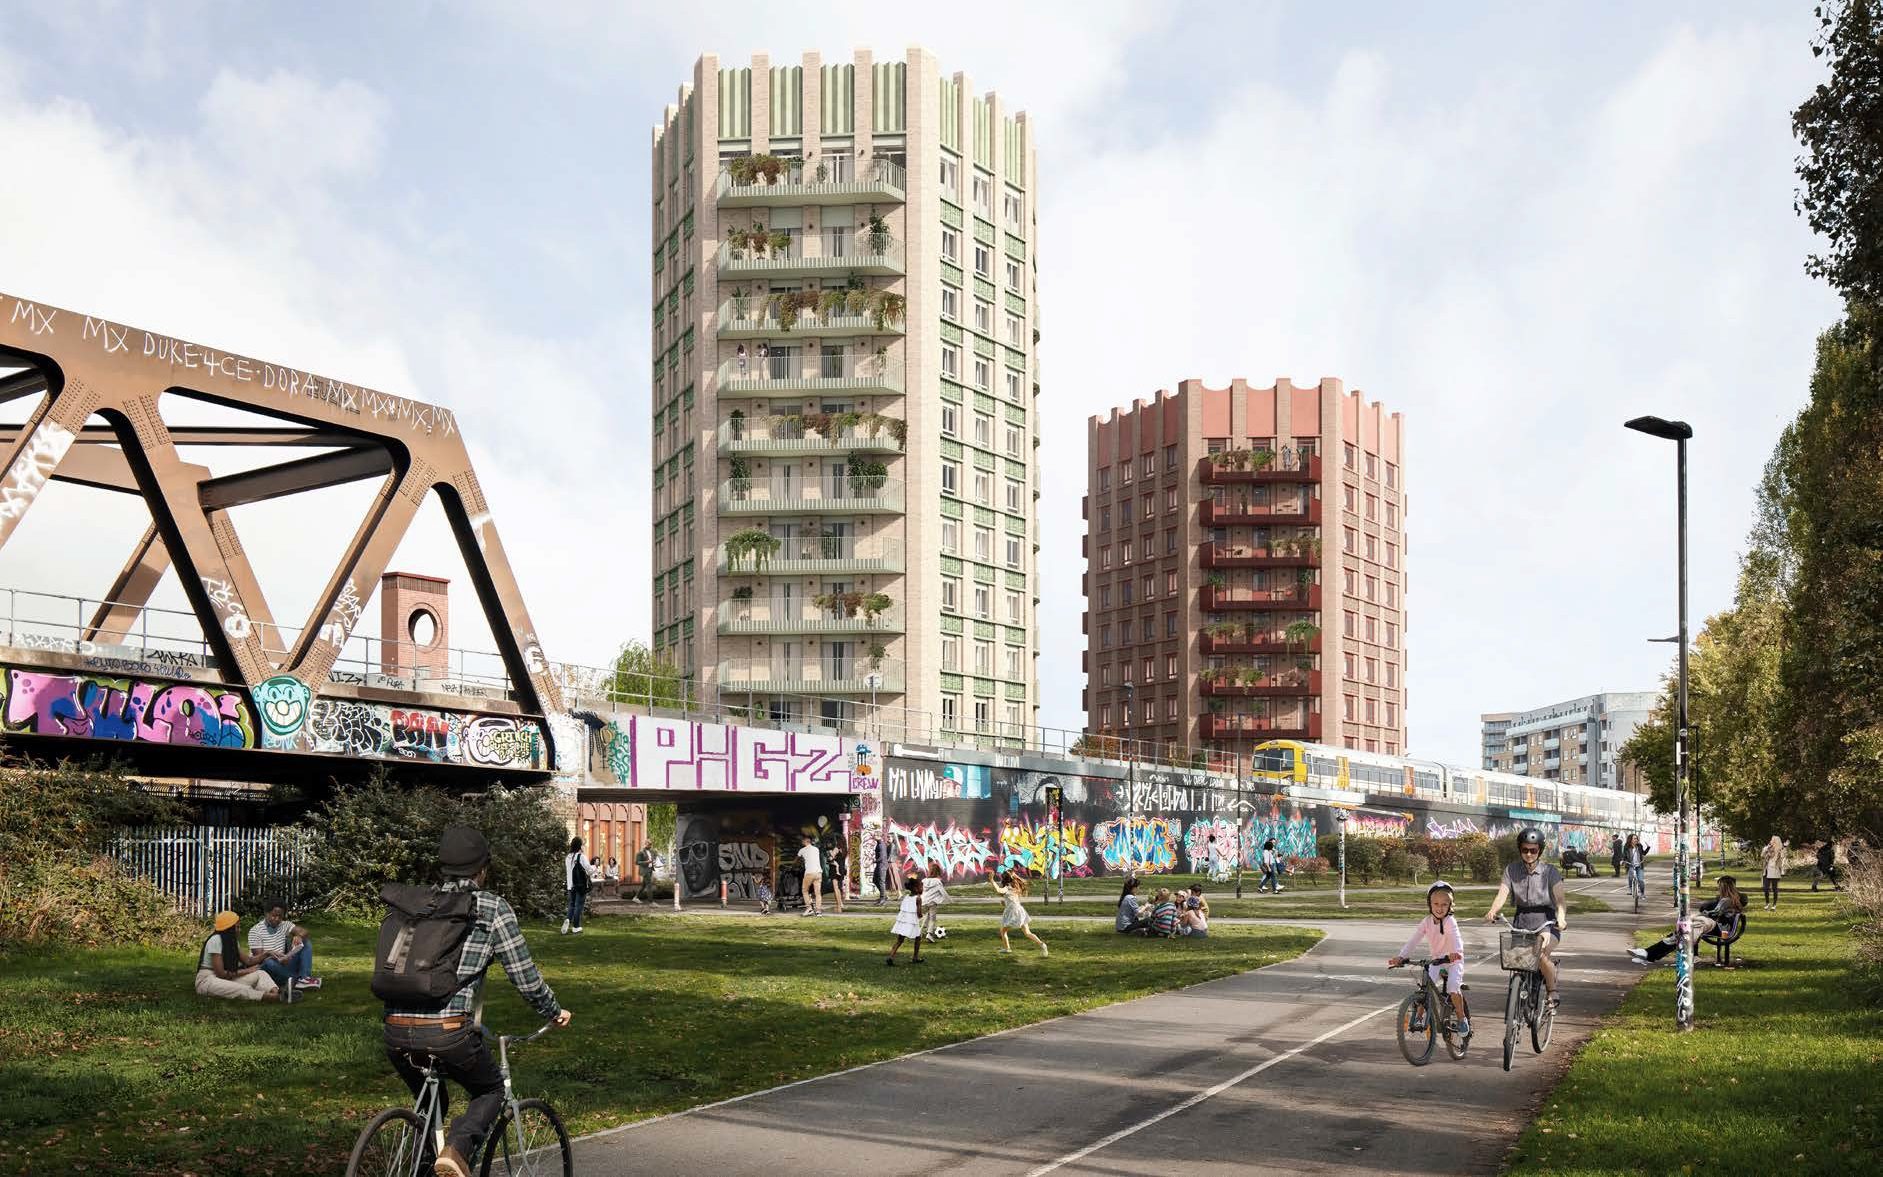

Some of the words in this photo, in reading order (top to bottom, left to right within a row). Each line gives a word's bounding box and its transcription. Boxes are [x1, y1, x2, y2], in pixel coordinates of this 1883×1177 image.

[11, 300, 57, 335] MX
[83, 315, 129, 353] MX
[852, 776, 879, 790] CREW
